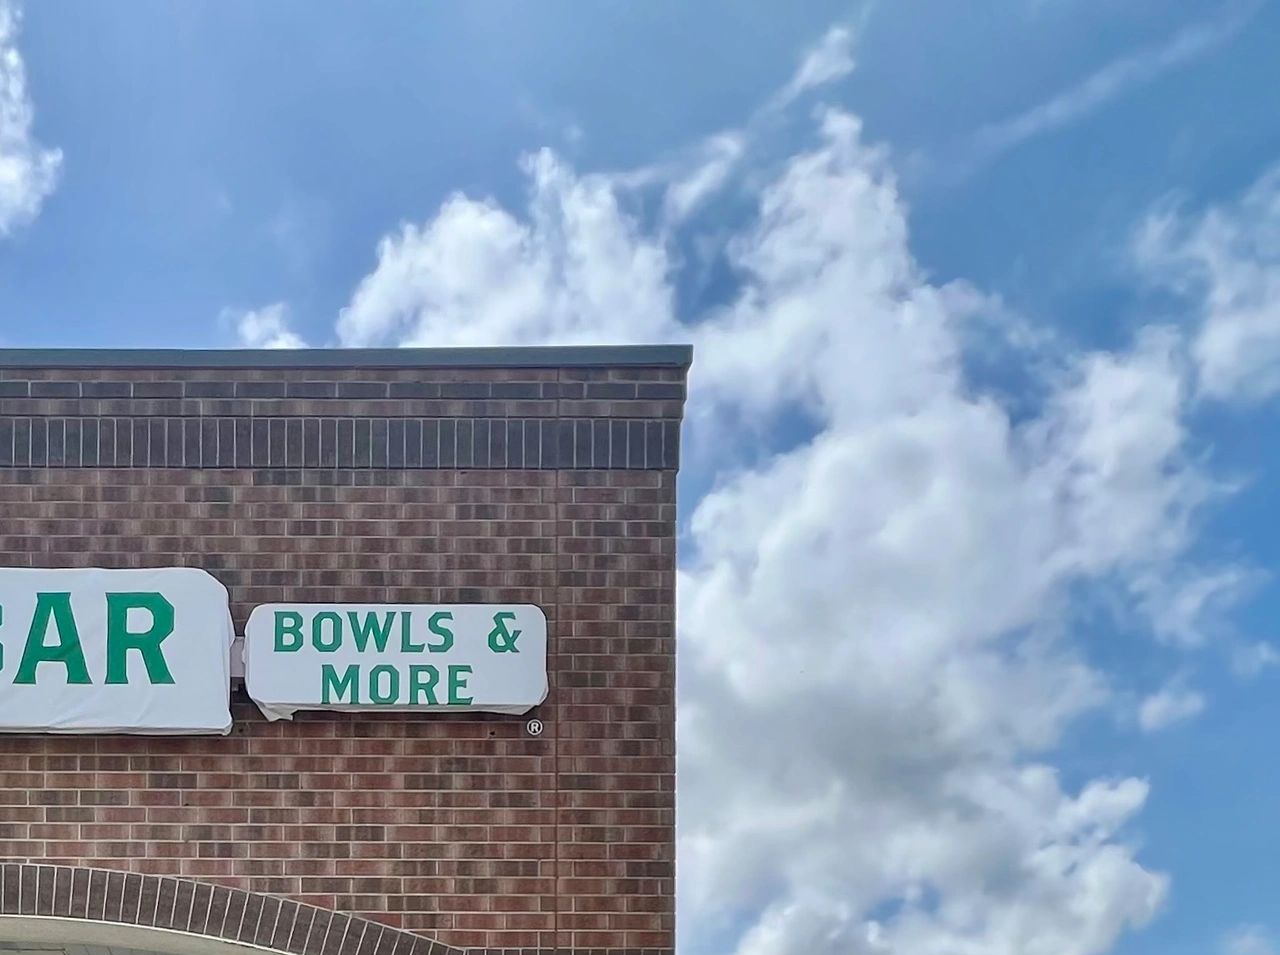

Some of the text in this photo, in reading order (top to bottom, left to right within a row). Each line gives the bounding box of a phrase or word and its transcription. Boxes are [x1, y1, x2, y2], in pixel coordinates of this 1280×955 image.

[273, 611, 523, 653] BOWLS &
[321, 664, 474, 705] MORE
